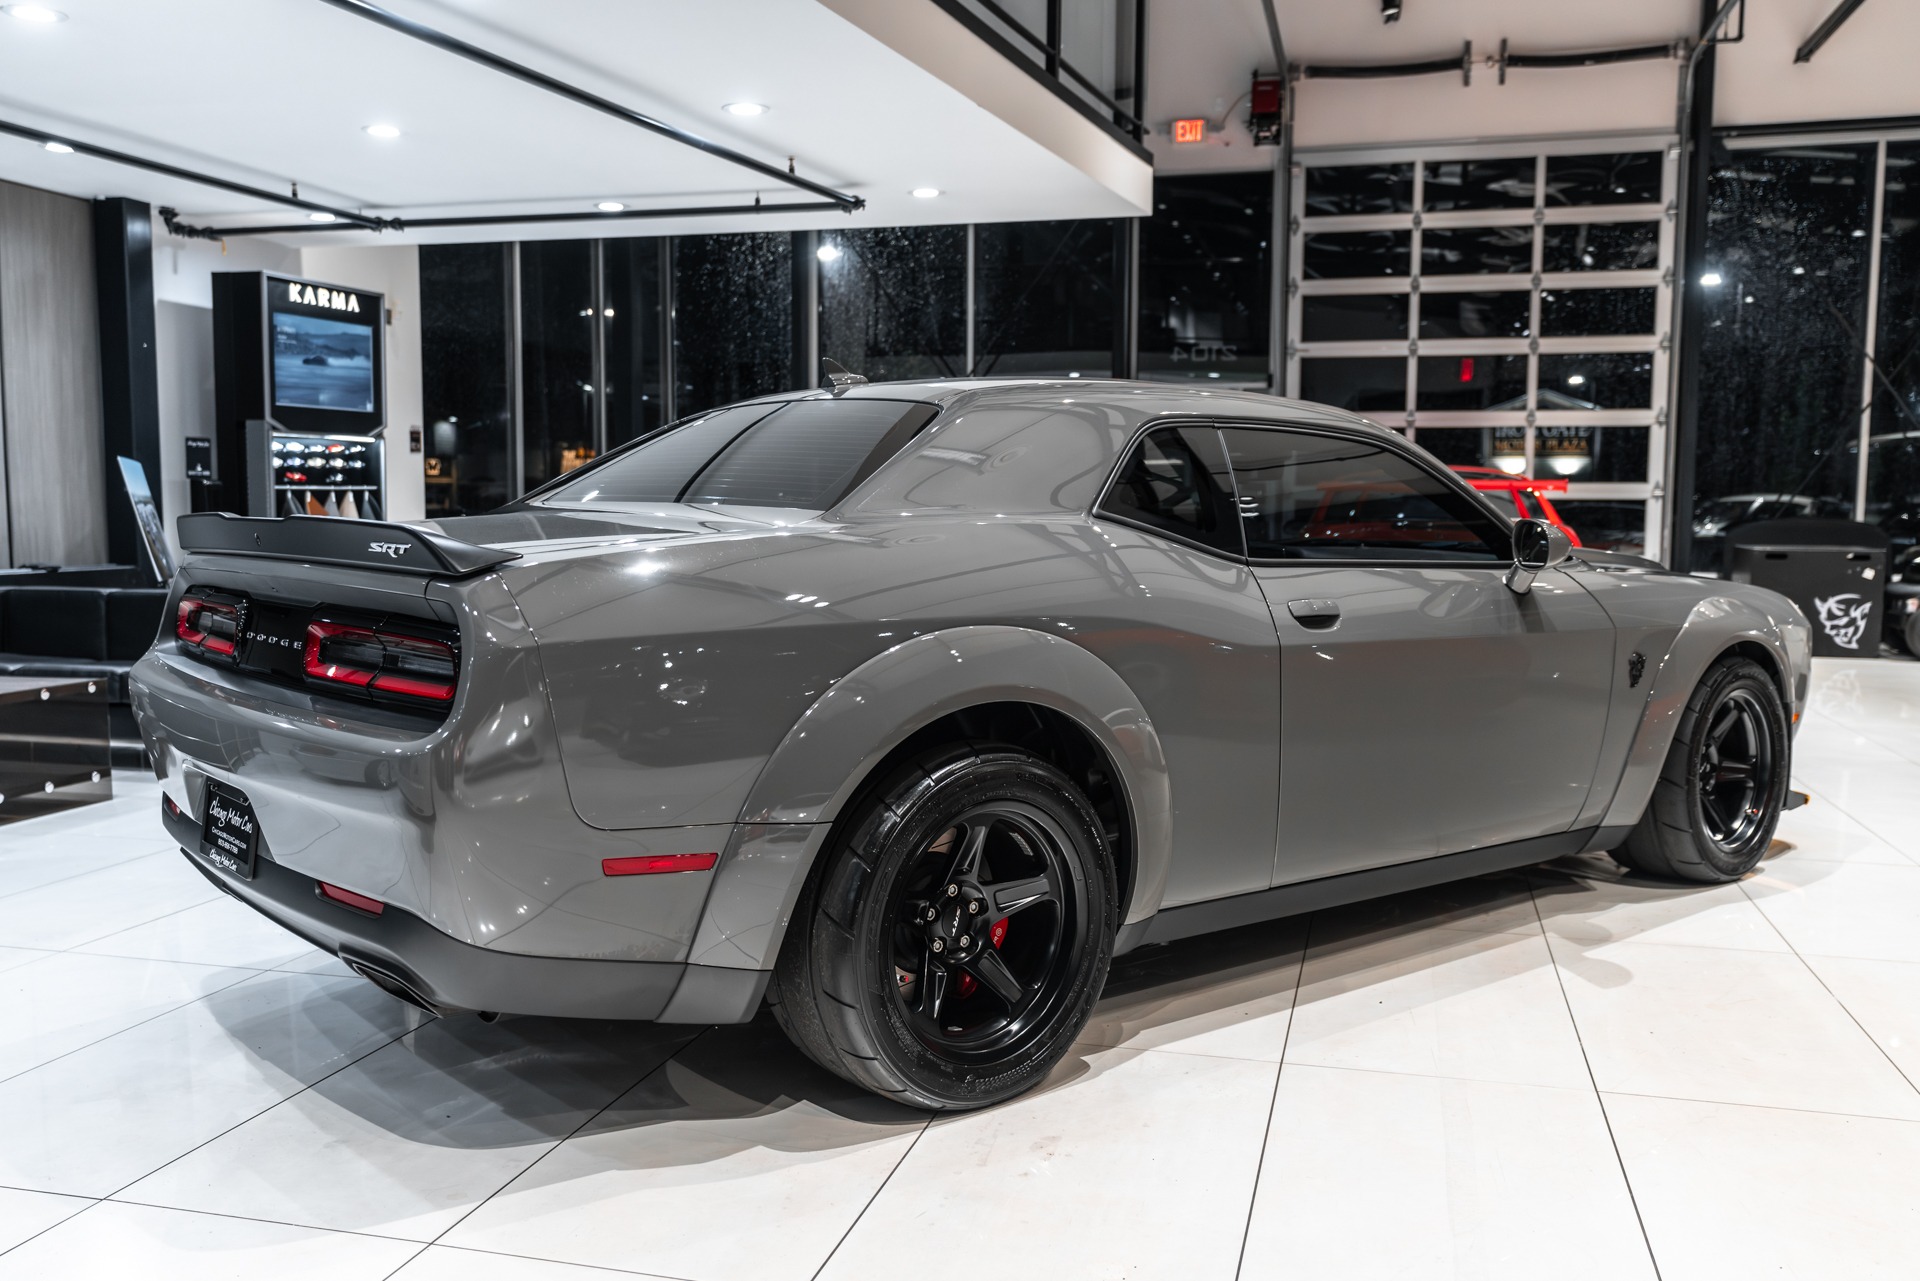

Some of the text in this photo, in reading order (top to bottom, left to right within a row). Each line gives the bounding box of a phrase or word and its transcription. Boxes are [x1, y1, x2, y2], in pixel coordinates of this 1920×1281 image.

[1176, 120, 1204, 142] EXIT
[288, 282, 360, 313] KARMA
[368, 542, 412, 558] SRT
[246, 631, 303, 650] DODGE
[209, 796, 253, 834] Chicago Motor Cars
[952, 906, 961, 937] SRT
